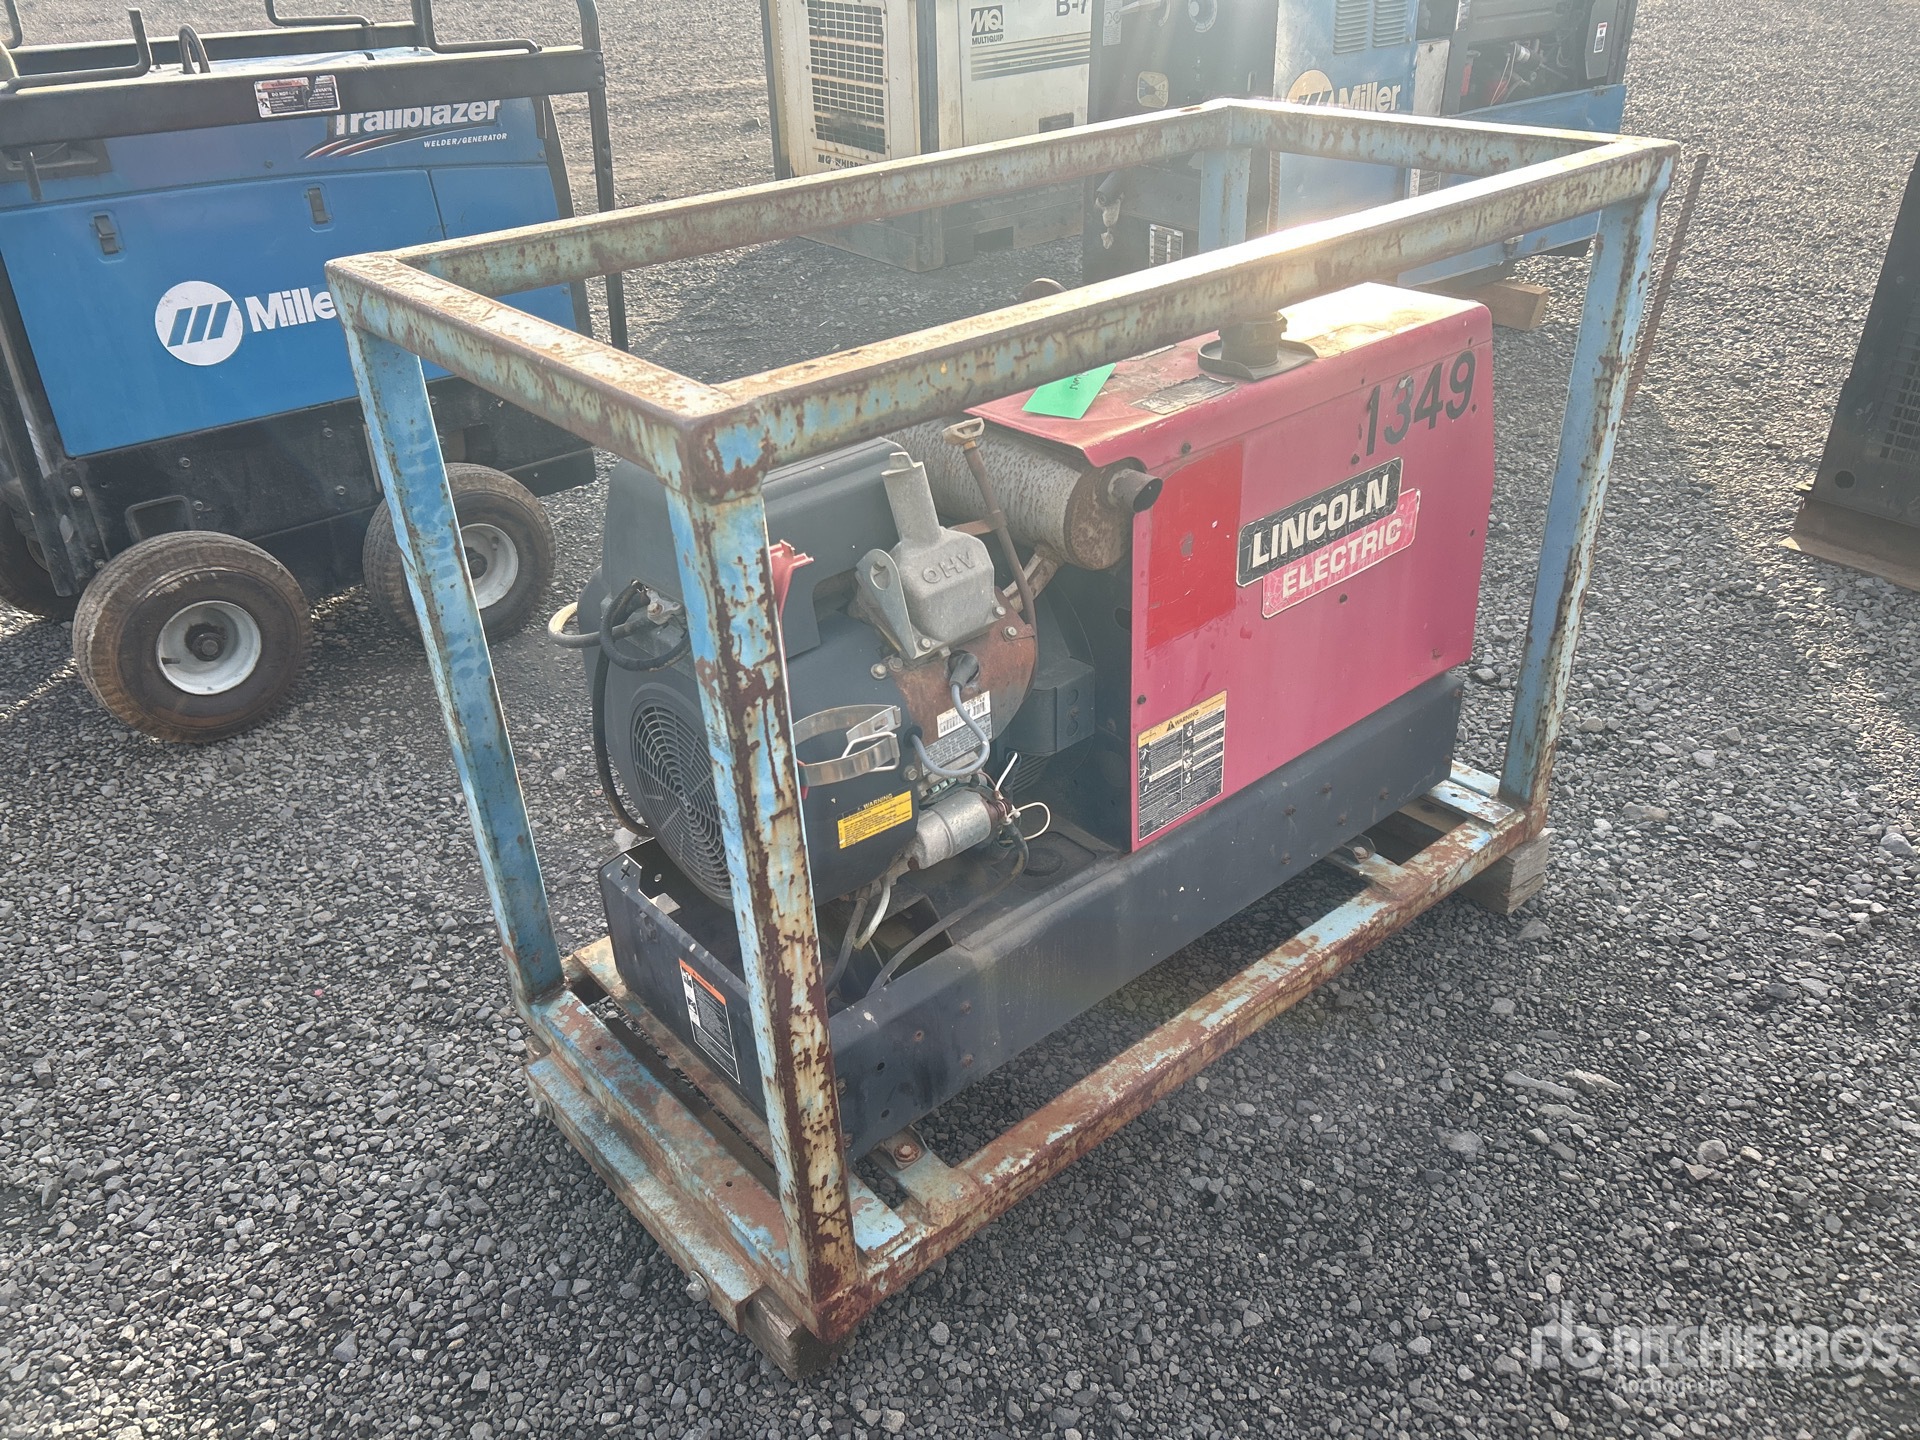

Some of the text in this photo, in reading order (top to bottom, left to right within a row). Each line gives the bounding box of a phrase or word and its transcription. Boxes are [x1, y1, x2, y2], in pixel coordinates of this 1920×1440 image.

[972, 34, 1004, 45] MULTIQUIP
[1338, 82, 1401, 112] Miller
[423, 133, 508, 148] WELDER/GENERATOR
[244, 287, 337, 332] Mille
[1366, 350, 1476, 456] 1349
[1251, 474, 1390, 569] LINCOLN
[922, 551, 976, 584] OHV
[1282, 519, 1402, 599] ELECTRIC
[1174, 709, 1200, 726] WARNING
[863, 793, 893, 810] WARNING
